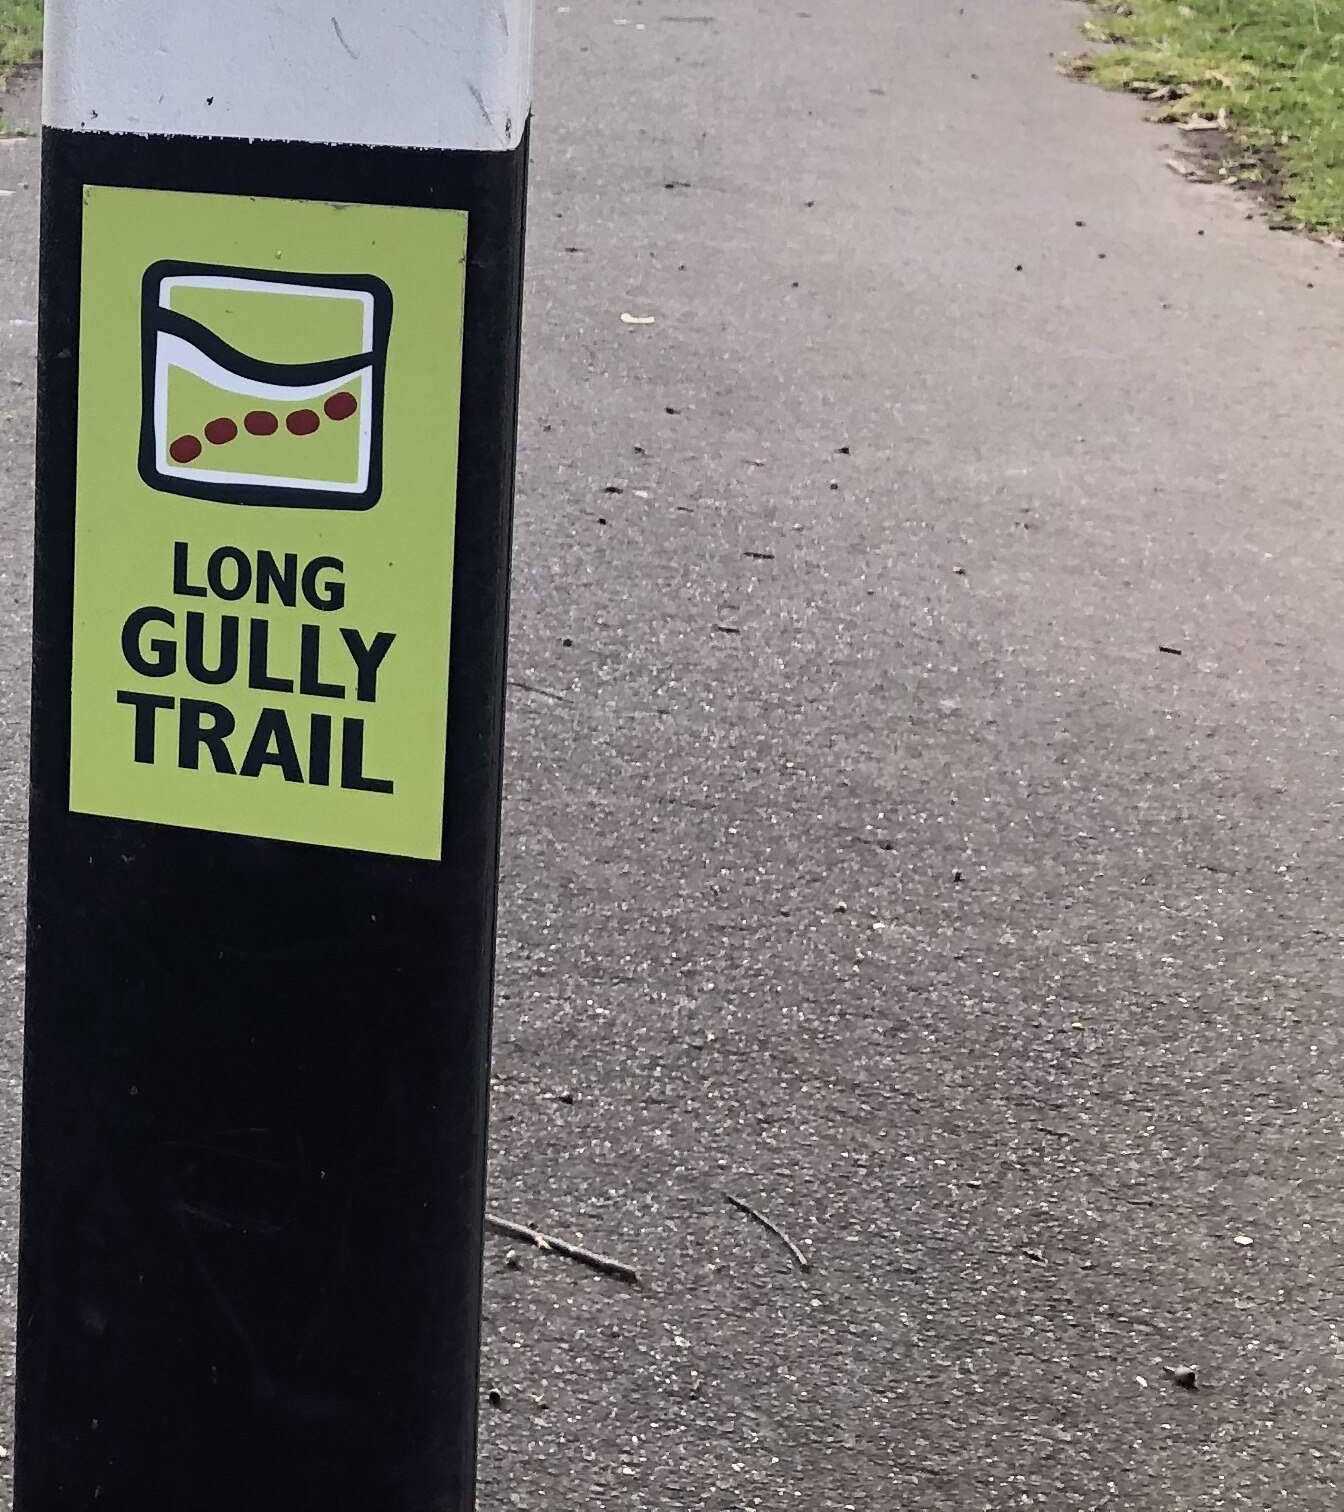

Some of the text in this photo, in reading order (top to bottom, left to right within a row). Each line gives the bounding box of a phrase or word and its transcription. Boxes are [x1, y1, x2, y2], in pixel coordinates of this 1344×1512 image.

[173, 541, 346, 611] LONG
[121, 606, 397, 702] GULLY
[117, 690, 394, 794] TRAIL
